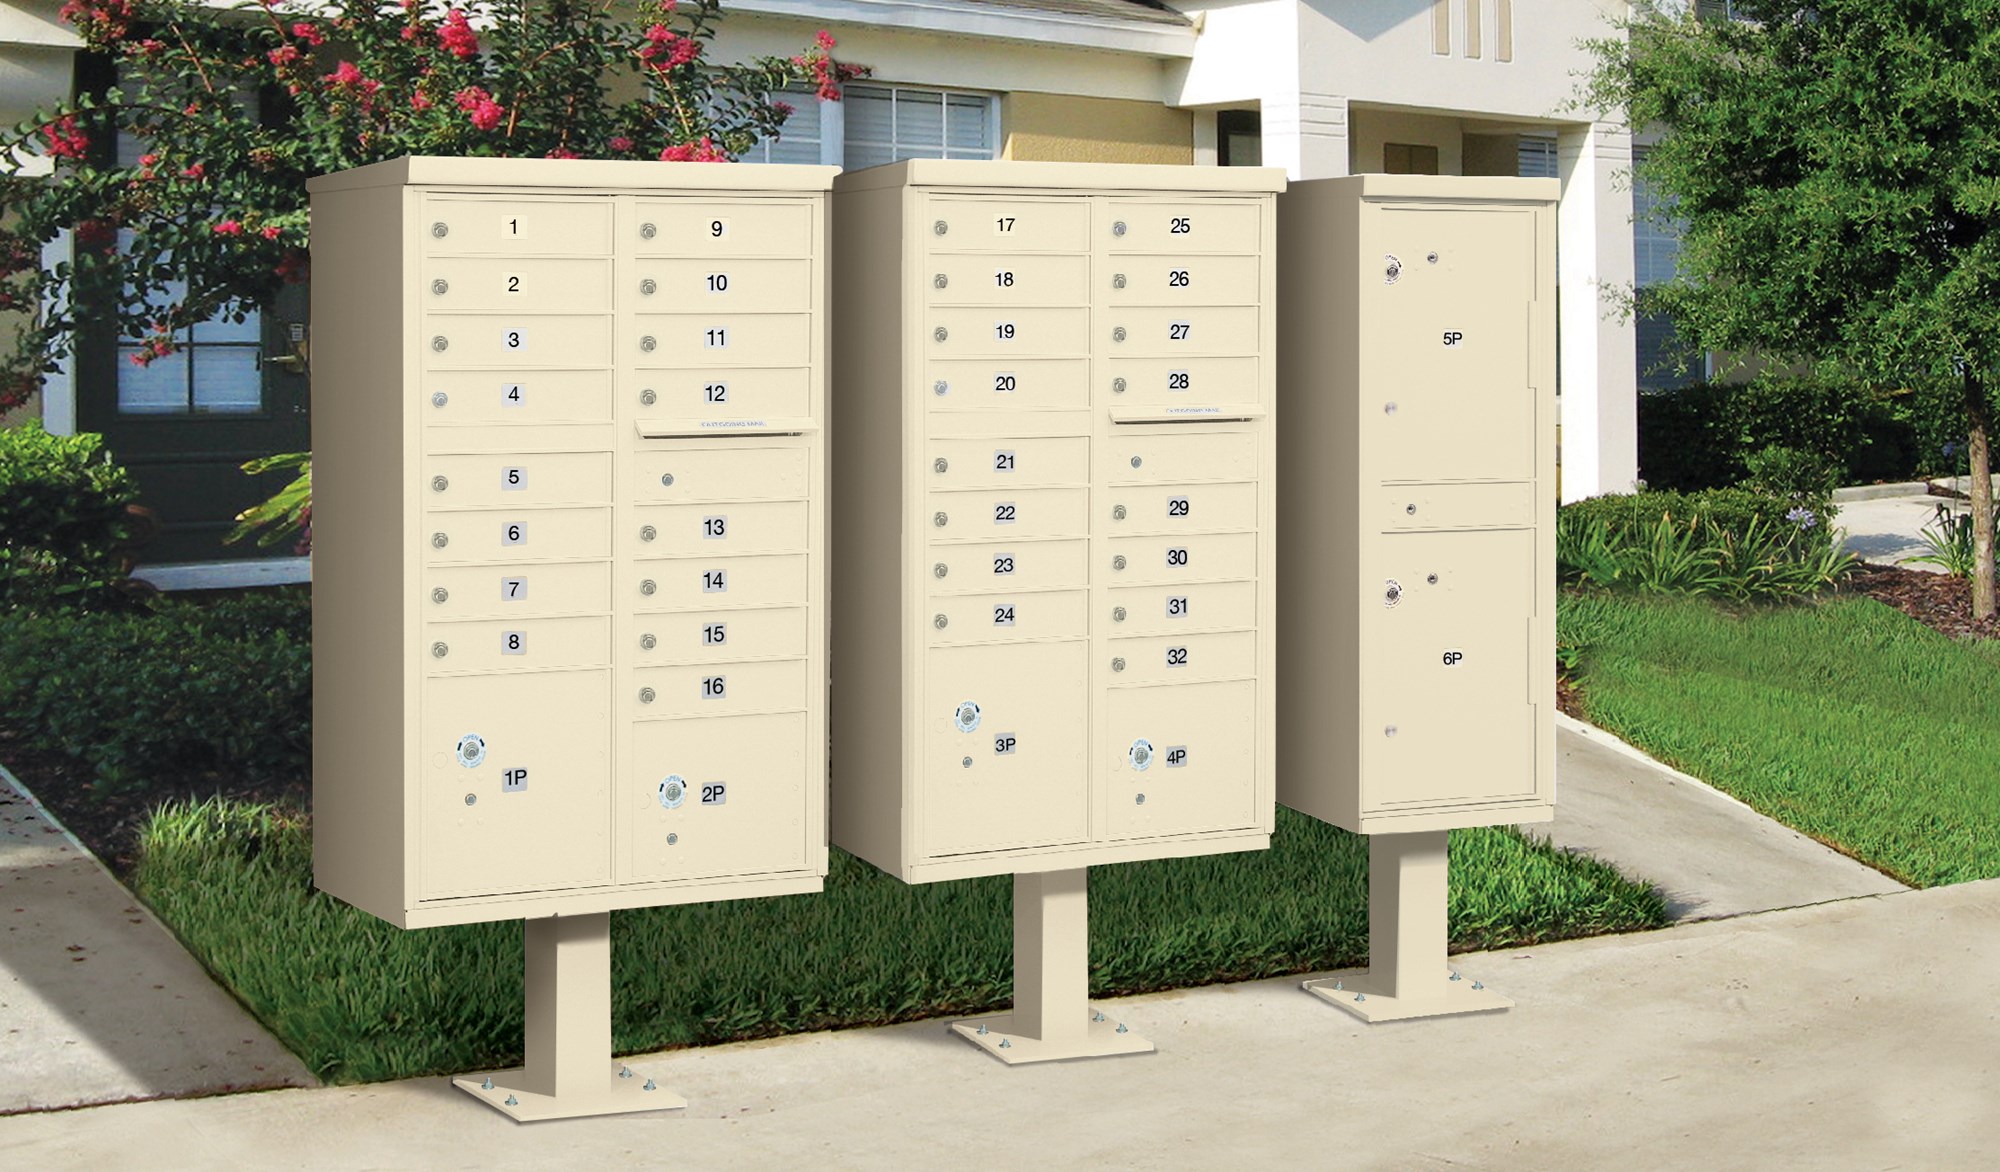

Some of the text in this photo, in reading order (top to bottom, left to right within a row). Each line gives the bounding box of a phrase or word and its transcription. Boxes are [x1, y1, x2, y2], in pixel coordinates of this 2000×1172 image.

[509, 218, 517, 235] 1
[711, 220, 723, 237] 9
[996, 217, 1016, 232] 17
[1170, 217, 1191, 234] 25
[508, 276, 519, 292] 2
[707, 274, 728, 291] 10
[995, 271, 1014, 287] 18
[1169, 270, 1190, 287] 26
[707, 329, 724, 346] 11
[995, 323, 1015, 339] 19
[1170, 323, 1190, 340] 27
[1443, 331, 1463, 346] 5P
[508, 332, 520, 348] 3
[995, 376, 1016, 391] 20
[1169, 373, 1190, 390] 28
[508, 386, 520, 402] 4
[705, 385, 725, 402] 12
[996, 454, 1014, 469] 21
[508, 469, 520, 485] 5
[995, 505, 1016, 521] 22
[1169, 500, 1190, 516] 29
[508, 525, 520, 541] 6
[704, 518, 725, 536] 13
[994, 557, 1014, 574] 23
[1167, 549, 1188, 566] 30
[703, 572, 724, 589] 14
[508, 581, 520, 597] 7
[1169, 598, 1187, 615] 31
[994, 607, 1015, 623] 24
[508, 633, 520, 650] 8
[704, 625, 725, 643] 15
[1167, 647, 1188, 665] 32
[1442, 651, 1463, 666] 6P
[703, 677, 724, 696] 16
[462, 733, 479, 743] OPEN
[995, 737, 1017, 753] 3P
[1166, 749, 1186, 765] 4P
[504, 769, 528, 786] 1P
[664, 774, 681, 784] OPEN
[701, 785, 725, 803] 2P
